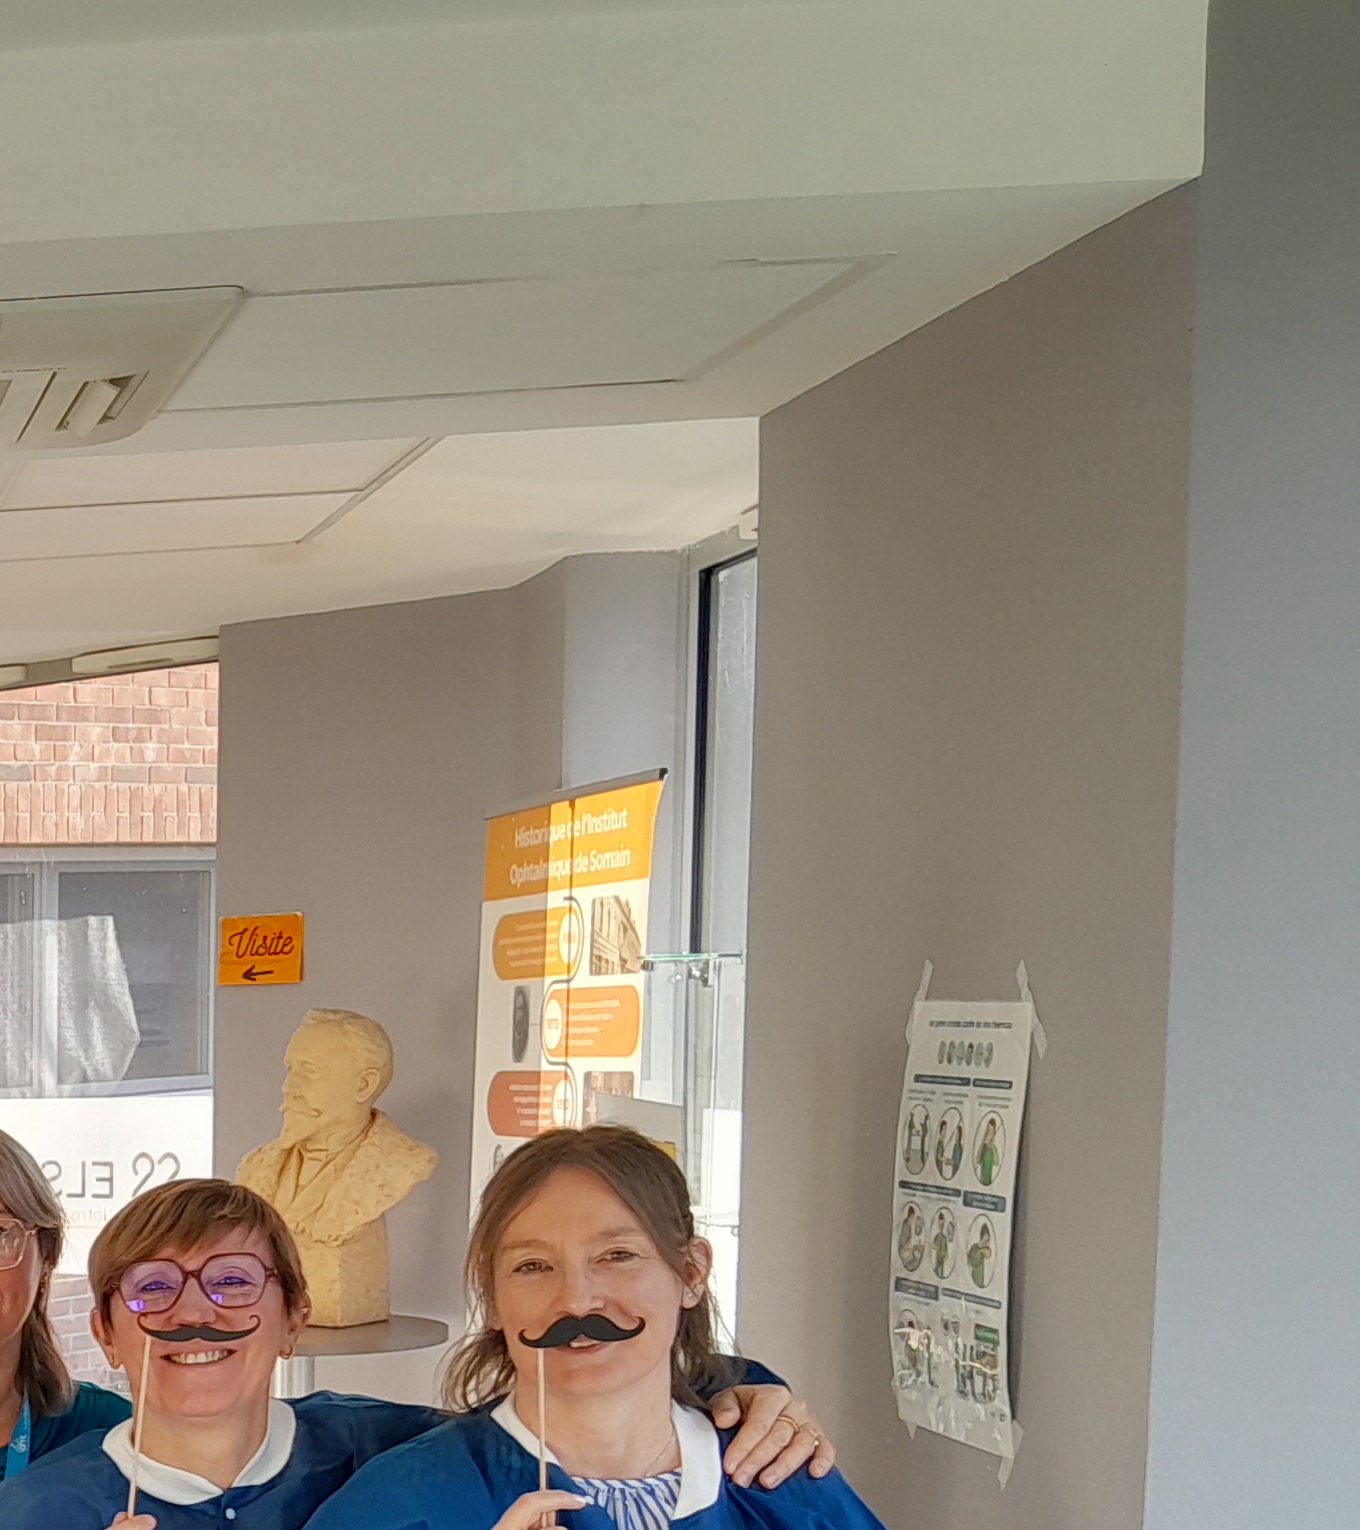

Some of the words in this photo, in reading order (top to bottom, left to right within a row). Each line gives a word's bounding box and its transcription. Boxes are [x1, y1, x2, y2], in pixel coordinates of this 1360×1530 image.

[514, 820, 566, 848] Historique
[574, 854, 589, 872] de
[590, 843, 630, 871] Somain
[228, 926, 295, 959] Visite
